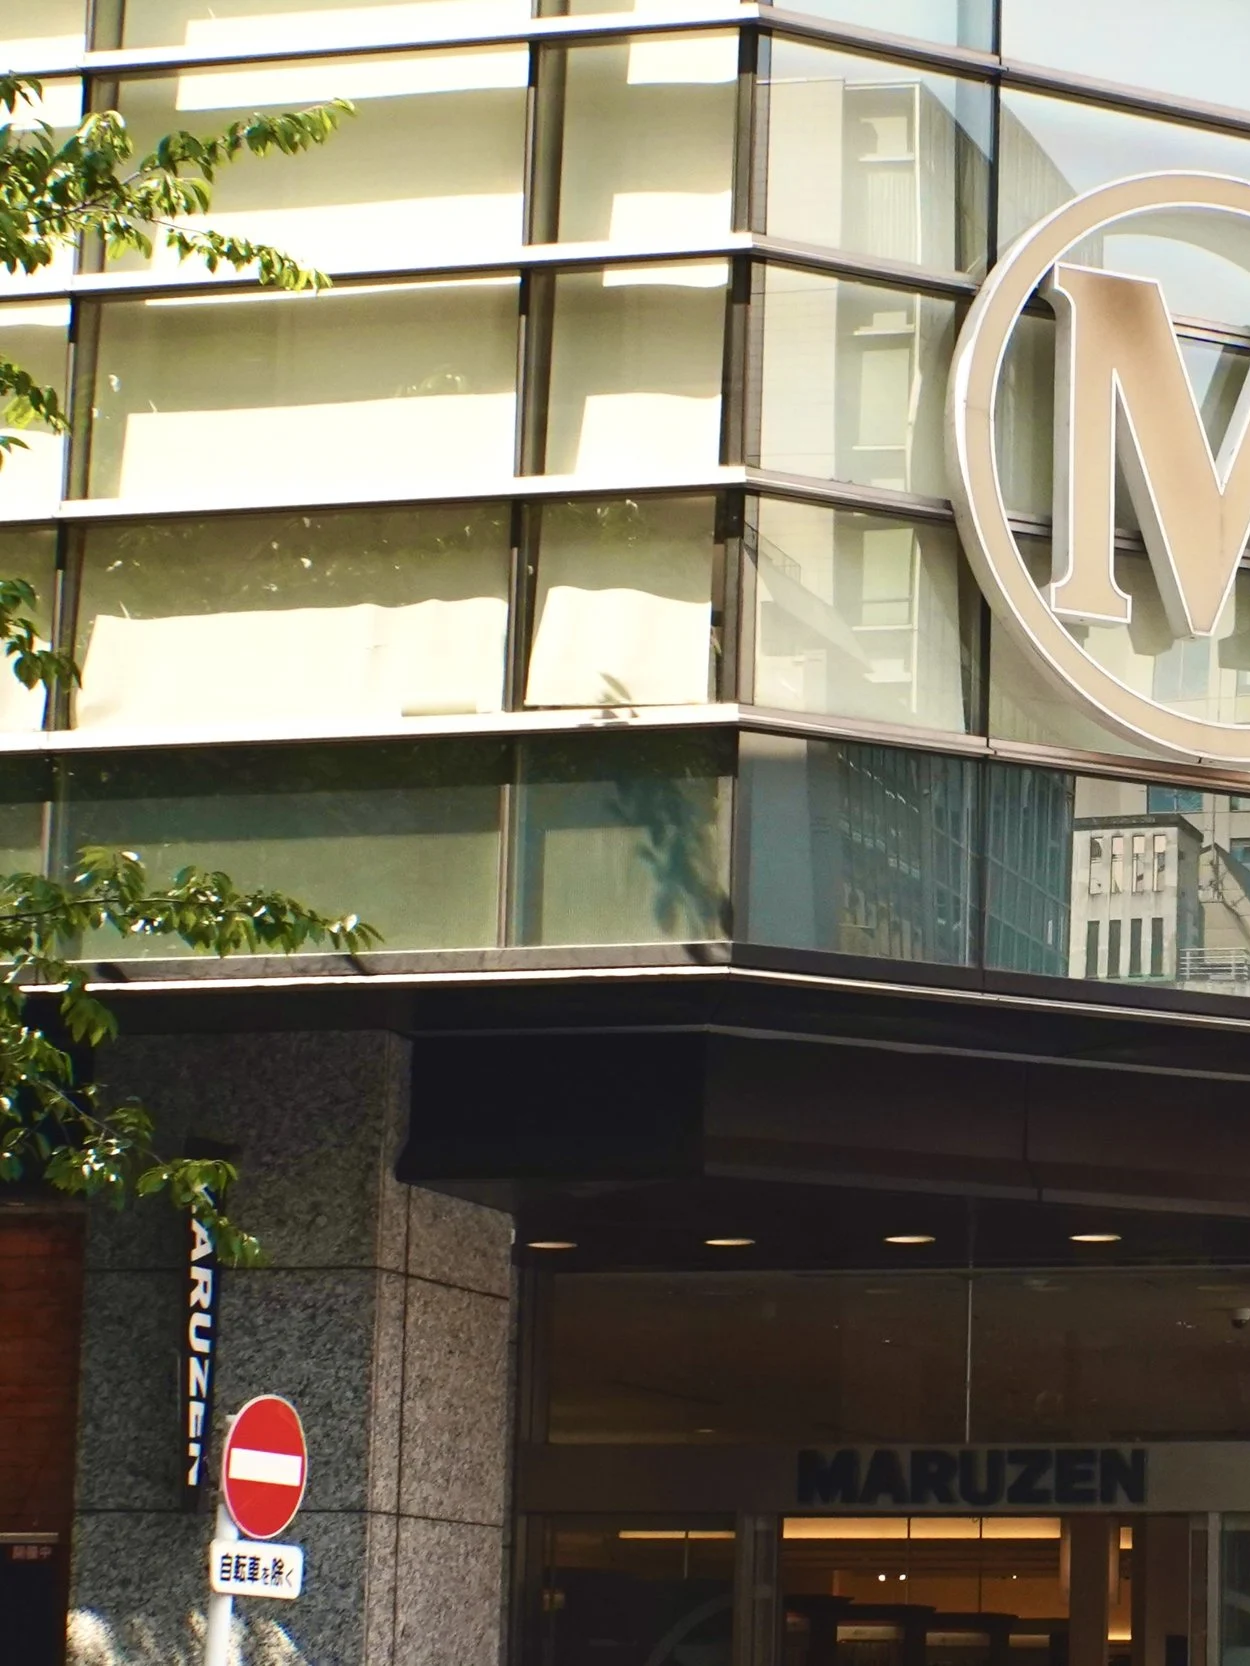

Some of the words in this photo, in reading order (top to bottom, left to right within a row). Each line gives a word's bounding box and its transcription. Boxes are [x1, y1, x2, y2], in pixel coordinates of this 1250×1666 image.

[797, 1448, 1149, 1506] MARUZEN
[220, 1552, 295, 1588] 自転車を除く
